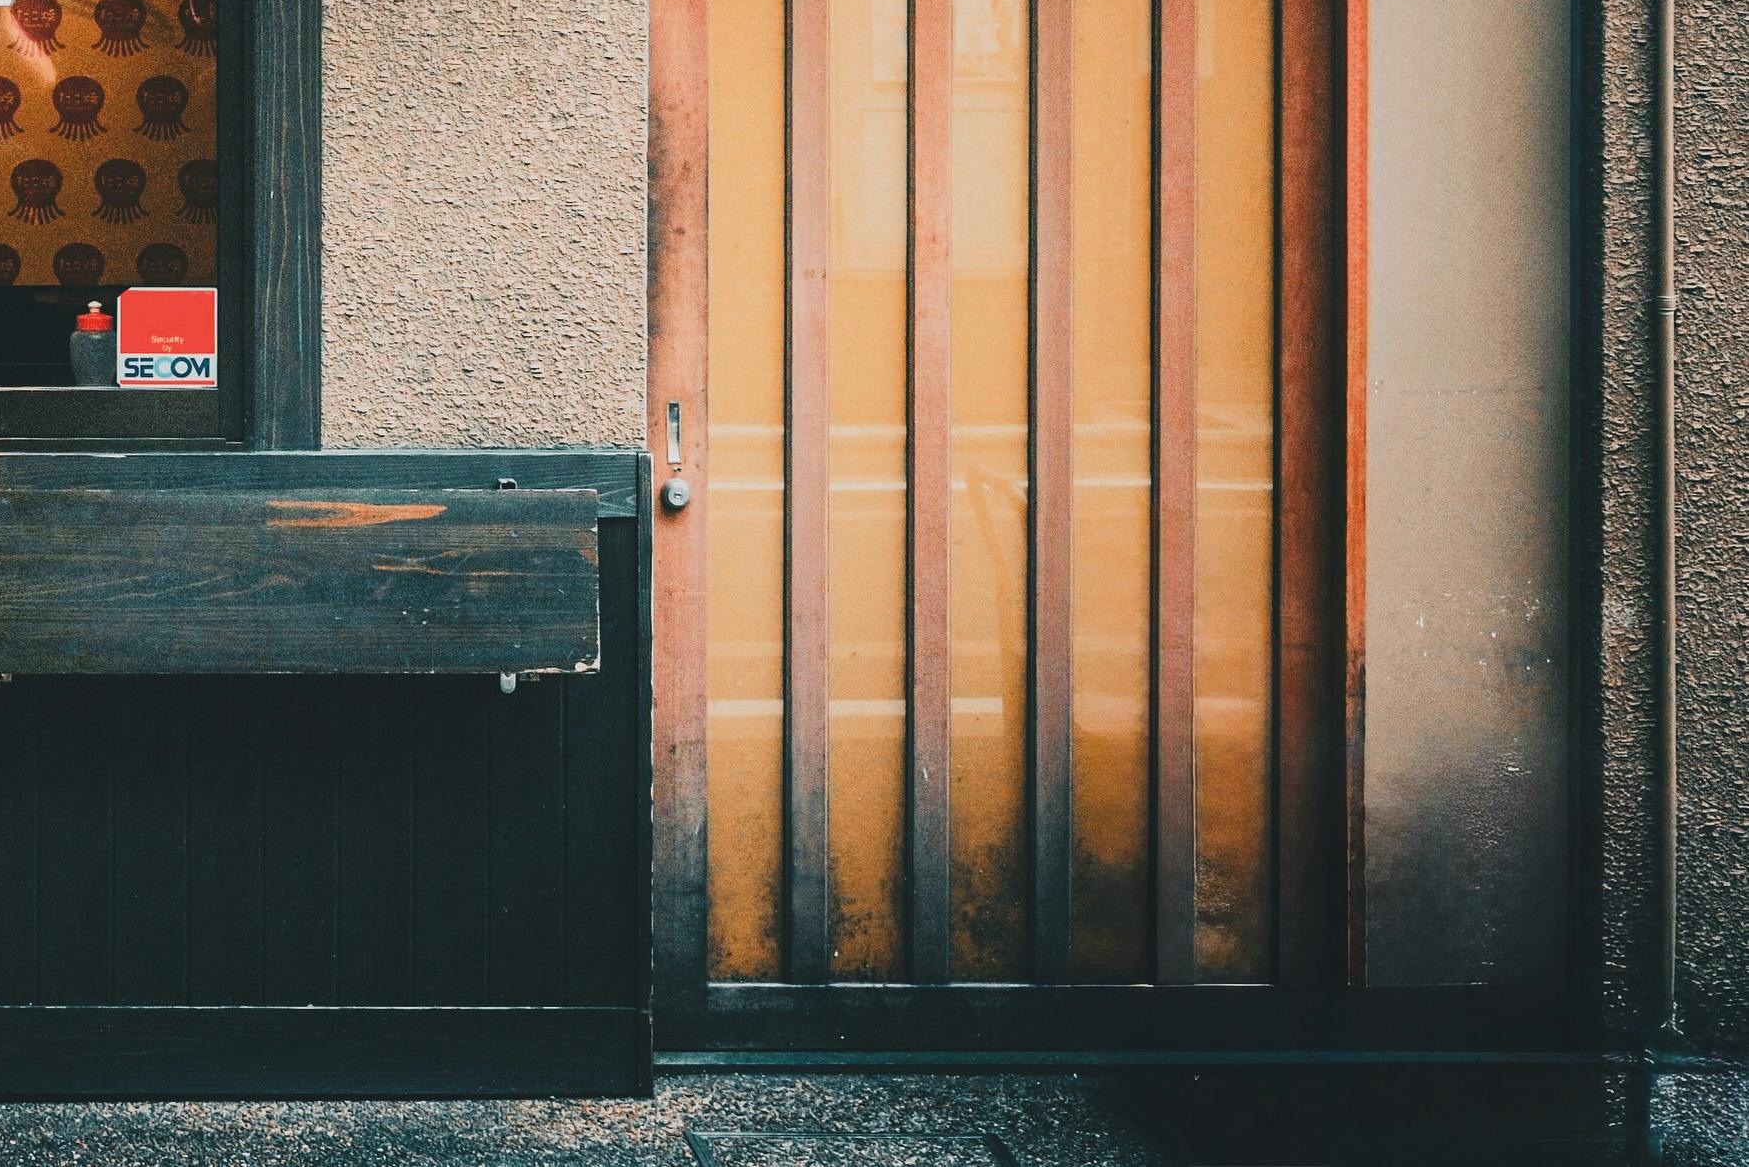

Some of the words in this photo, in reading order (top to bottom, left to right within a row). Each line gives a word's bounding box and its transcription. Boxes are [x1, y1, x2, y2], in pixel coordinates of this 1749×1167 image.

[151, 335, 184, 344] Security
[162, 344, 172, 353] by
[124, 356, 210, 379] SECOM
